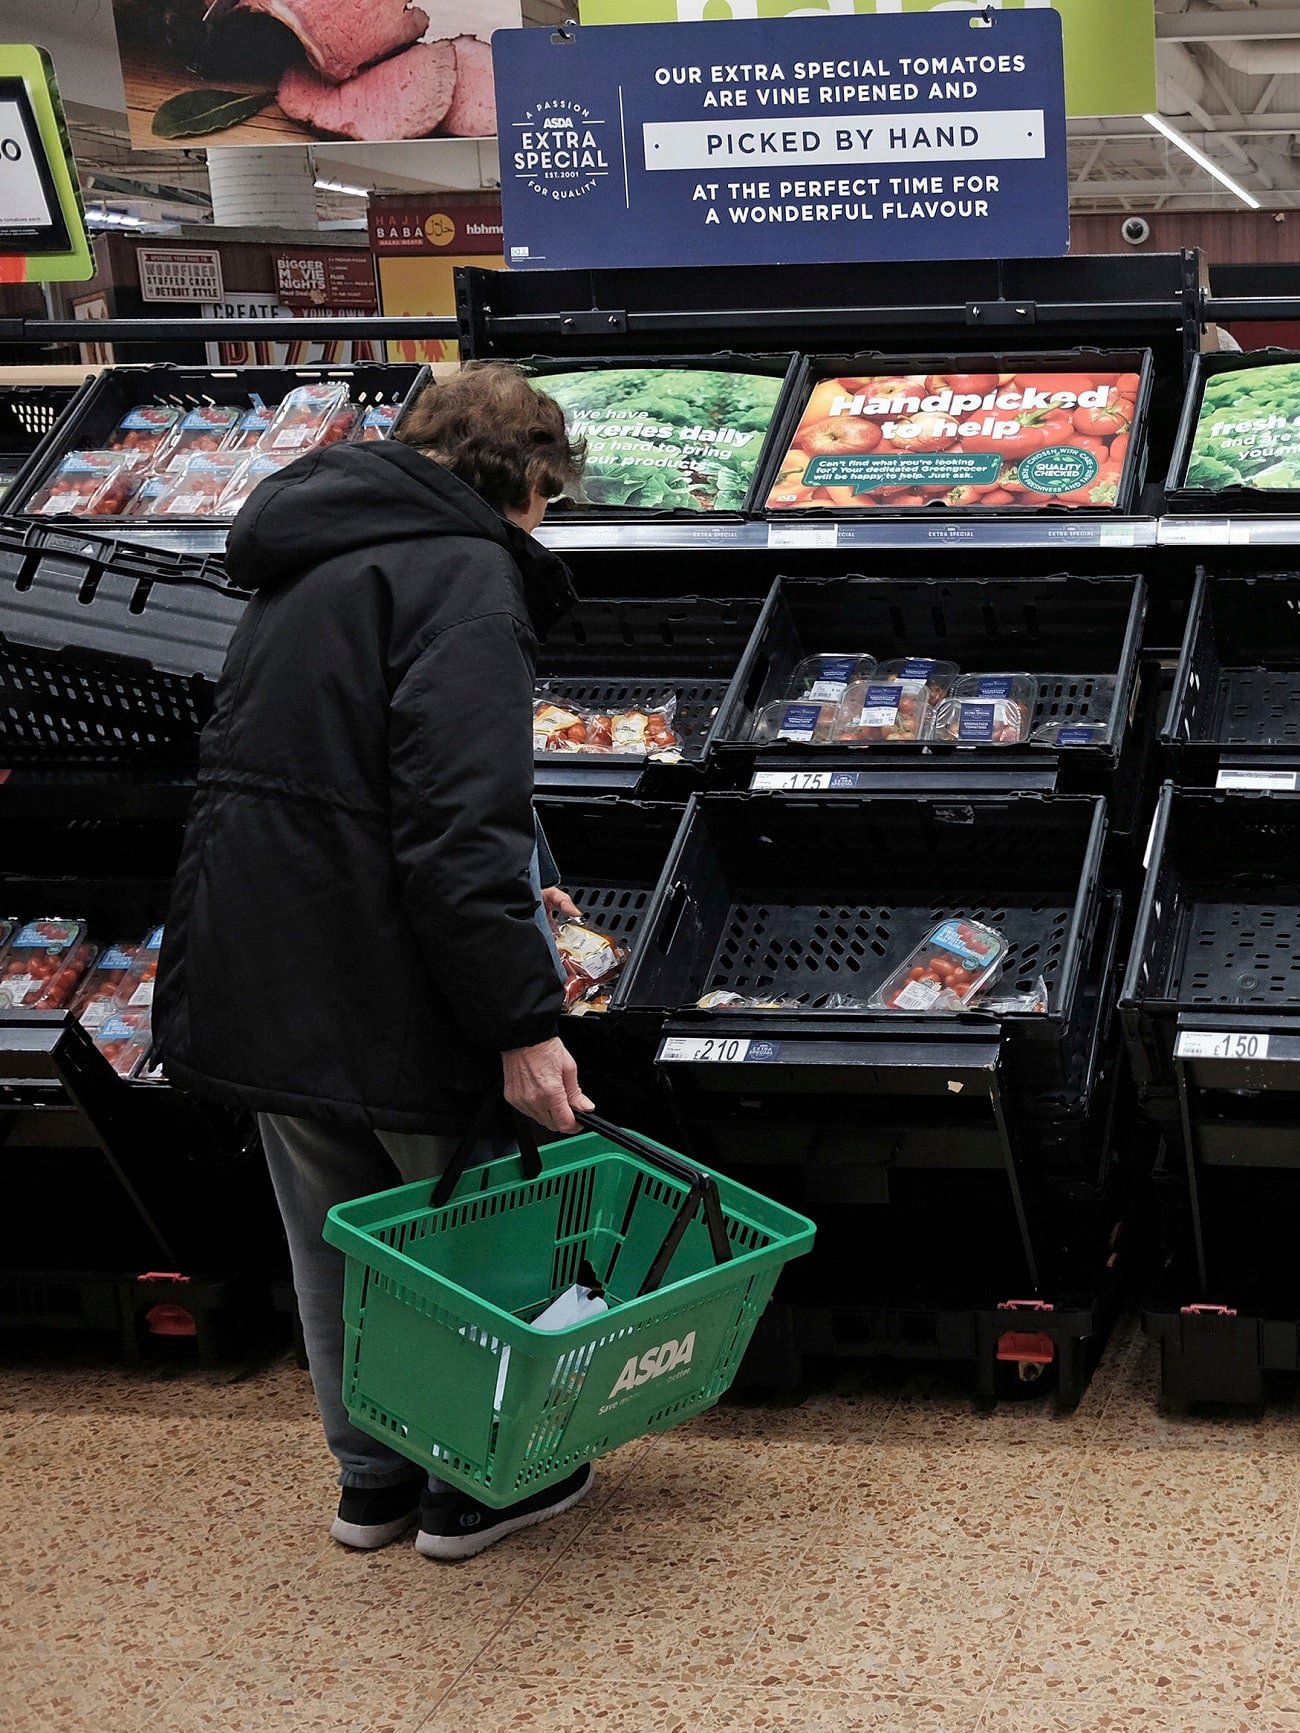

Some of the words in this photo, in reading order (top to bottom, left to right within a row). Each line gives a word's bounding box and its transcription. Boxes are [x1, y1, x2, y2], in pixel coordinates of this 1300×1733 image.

[655, 67, 701, 84] OUR
[711, 64, 785, 82] EXTRA
[794, 60, 891, 79] SPECIAL
[899, 55, 1025, 75] TOMATOES
[703, 90, 747, 107] ARE
[756, 88, 810, 106] VINE
[820, 84, 918, 103] RIPENED
[928, 82, 978, 99] AND
[536, 100, 589, 117] PASSION
[543, 118, 573, 128] ASDA
[522, 131, 596, 149] EXTRA
[708, 131, 821, 154] PICKED
[836, 129, 874, 150] BY
[889, 126, 979, 148] HAND
[514, 150, 608, 169] SPECIAL
[528, 180, 548, 195] FOR
[552, 179, 596, 200] QUALITY
[692, 184, 718, 200] AT
[728, 182, 771, 199] THE
[780, 178, 880, 197] PERFECT
[889, 178, 942, 194] TIME
[953, 175, 999, 192] FOR
[376, 216, 419, 225] HAJI
[705, 208, 720, 224] A
[729, 203, 873, 223] WONDERFUL
[882, 200, 988, 219] FLAVOUR
[377, 228, 423, 238] BABA
[277, 260, 323, 269] BIGGER
[147, 277, 185, 285] STUFFED
[189, 278, 216, 286] CRUST
[280, 280, 325, 289] NIGHTS
[193, 288, 218, 297] STYLE
[213, 304, 279, 318] CREATE
[829, 387, 1109, 417] Handpicked
[573, 409, 598, 419] We
[605, 409, 649, 419] have
[881, 421, 921, 439] to
[932, 418, 1021, 439] help
[1211, 413, 1286, 438] fresh
[679, 426, 755, 448] daily
[1221, 435, 1256, 448] and
[1262, 433, 1290, 444] are
[611, 441, 653, 451] hard
[660, 445, 676, 453] to
[683, 444, 733, 459] bring
[1238, 449, 1274, 461] you
[587, 456, 617, 464] our
[693, 1040, 739, 1060] £2.10
[1214, 1035, 1258, 1057] £1.50
[608, 1331, 695, 1399] ASDA
[599, 1401, 618, 1415] Save
